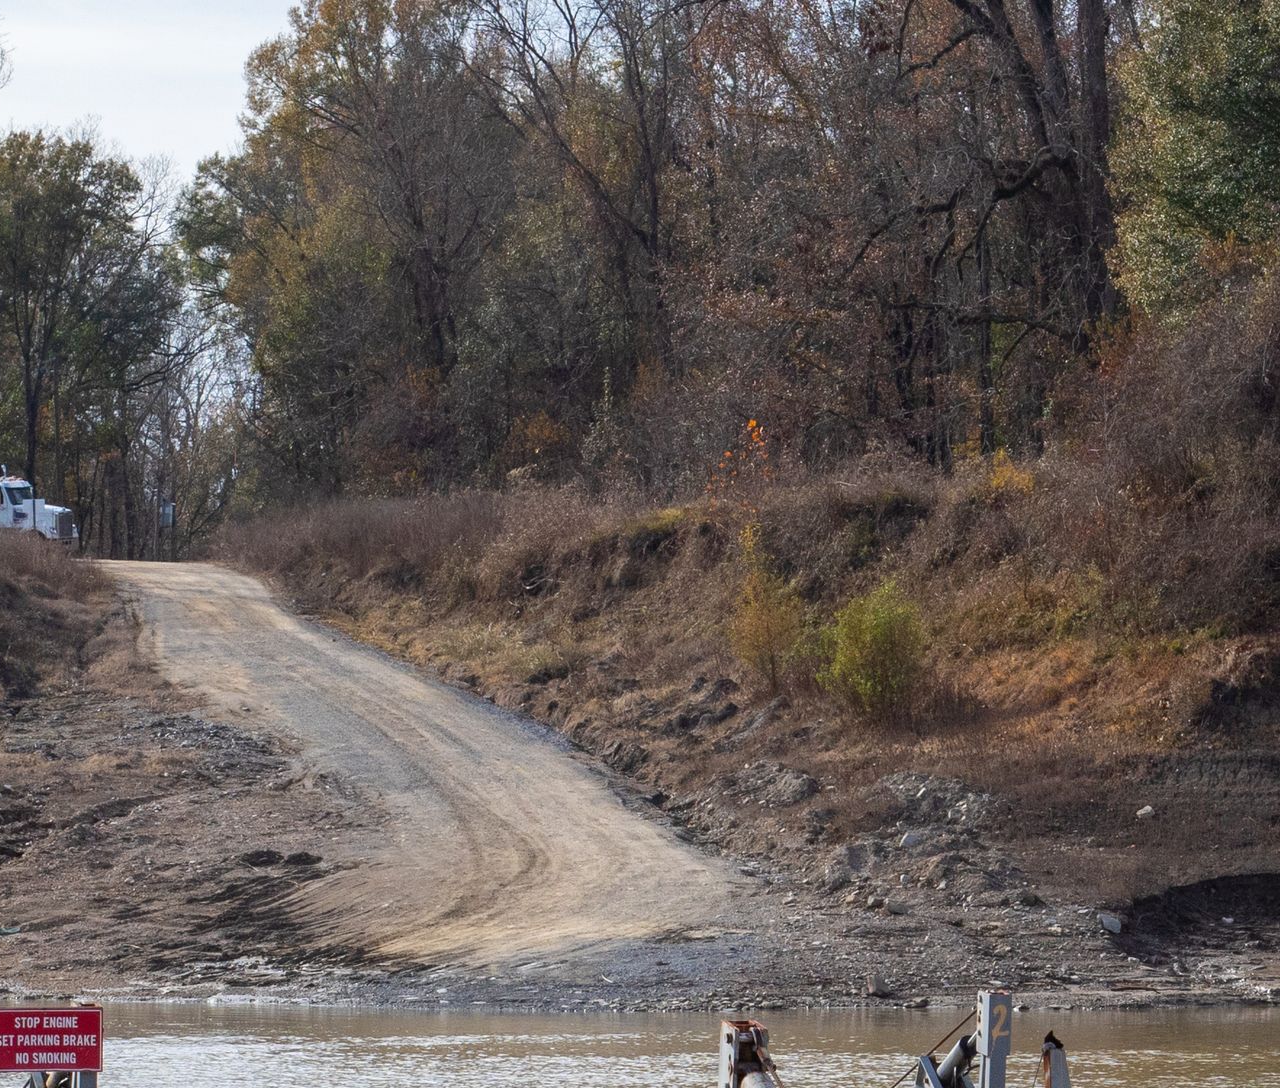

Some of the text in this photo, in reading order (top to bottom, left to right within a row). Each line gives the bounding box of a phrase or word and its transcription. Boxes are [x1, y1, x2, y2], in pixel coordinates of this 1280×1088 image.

[14, 1016, 78, 1028] STOP ENGINE
[991, 1004, 1009, 1037] 2
[17, 1034, 60, 1046] PARKING
[63, 1034, 97, 1046] BRAKE
[15, 1052, 77, 1064] NO SMOKING
